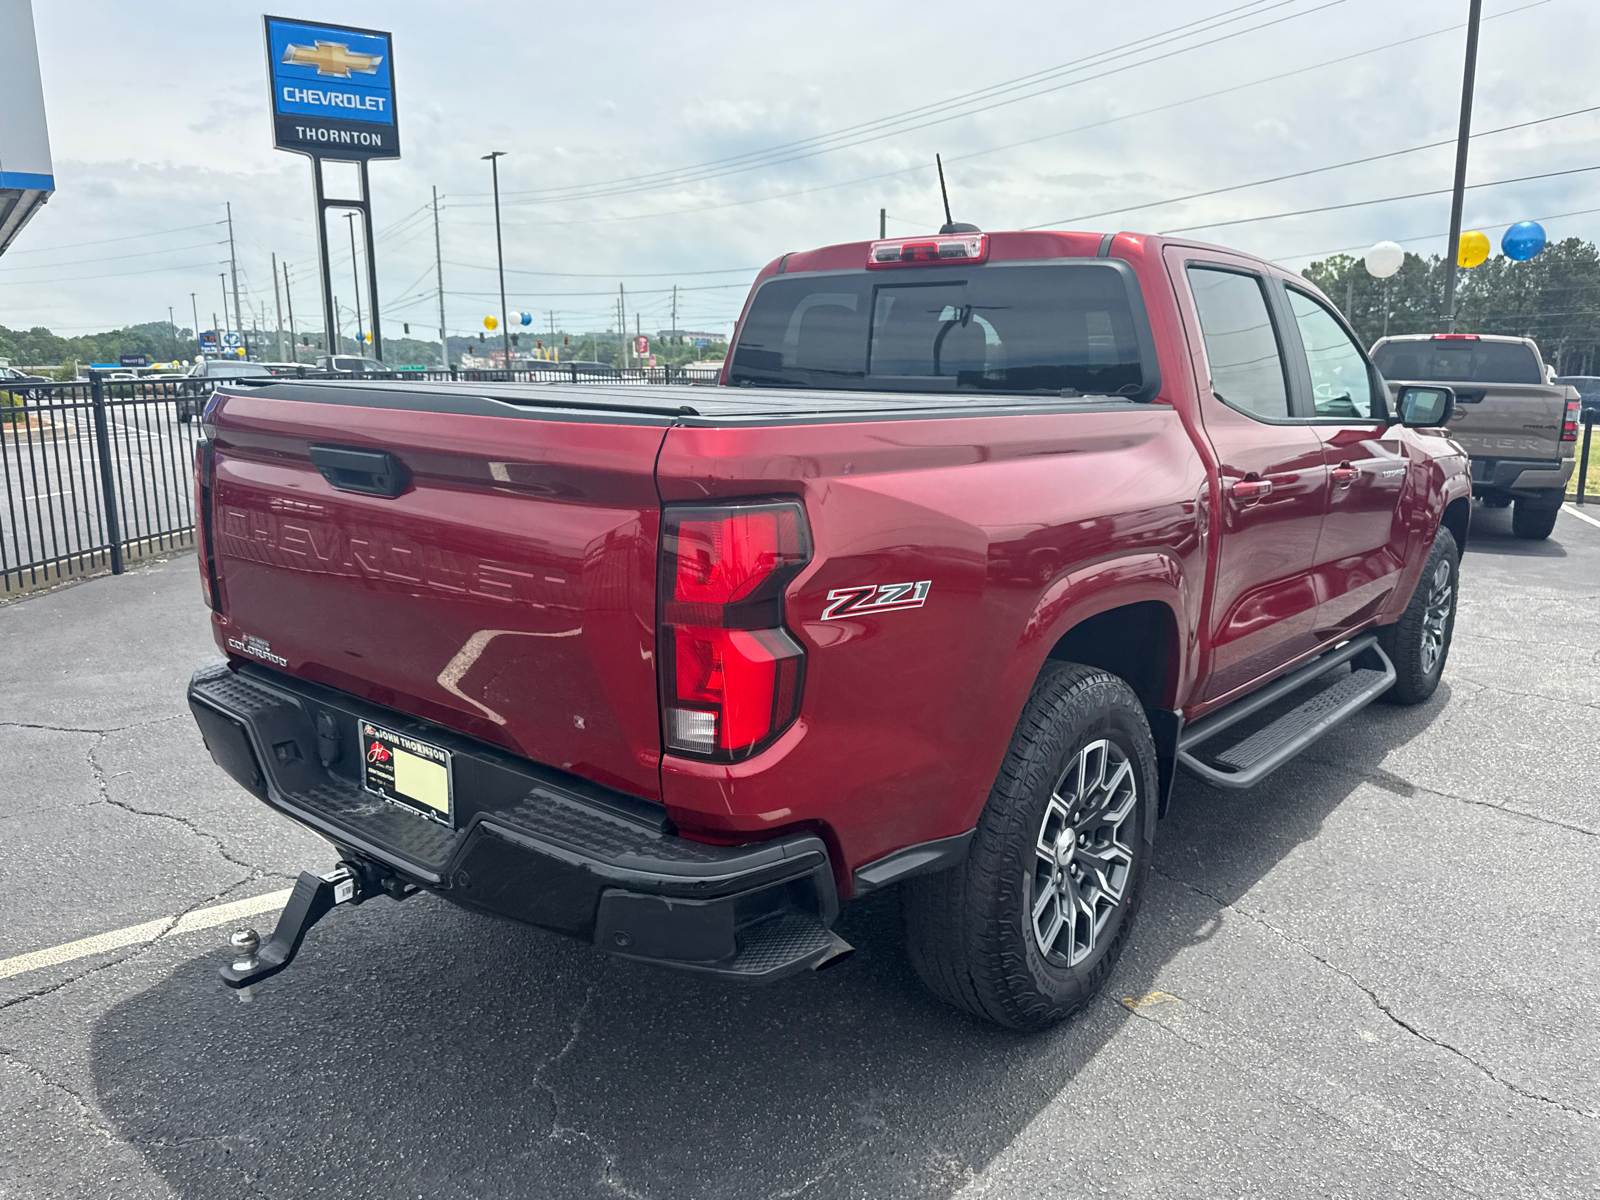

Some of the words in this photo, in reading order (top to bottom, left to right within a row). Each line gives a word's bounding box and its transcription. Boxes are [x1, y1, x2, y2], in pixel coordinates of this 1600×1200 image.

[283, 87, 386, 111] CHEVROLET
[296, 126, 382, 146] THORNTON
[820, 580, 932, 621] Z71
[228, 638, 288, 667] COLORADO
[379, 730, 400, 745] JOHN
[400, 738, 446, 762] THORNTON
